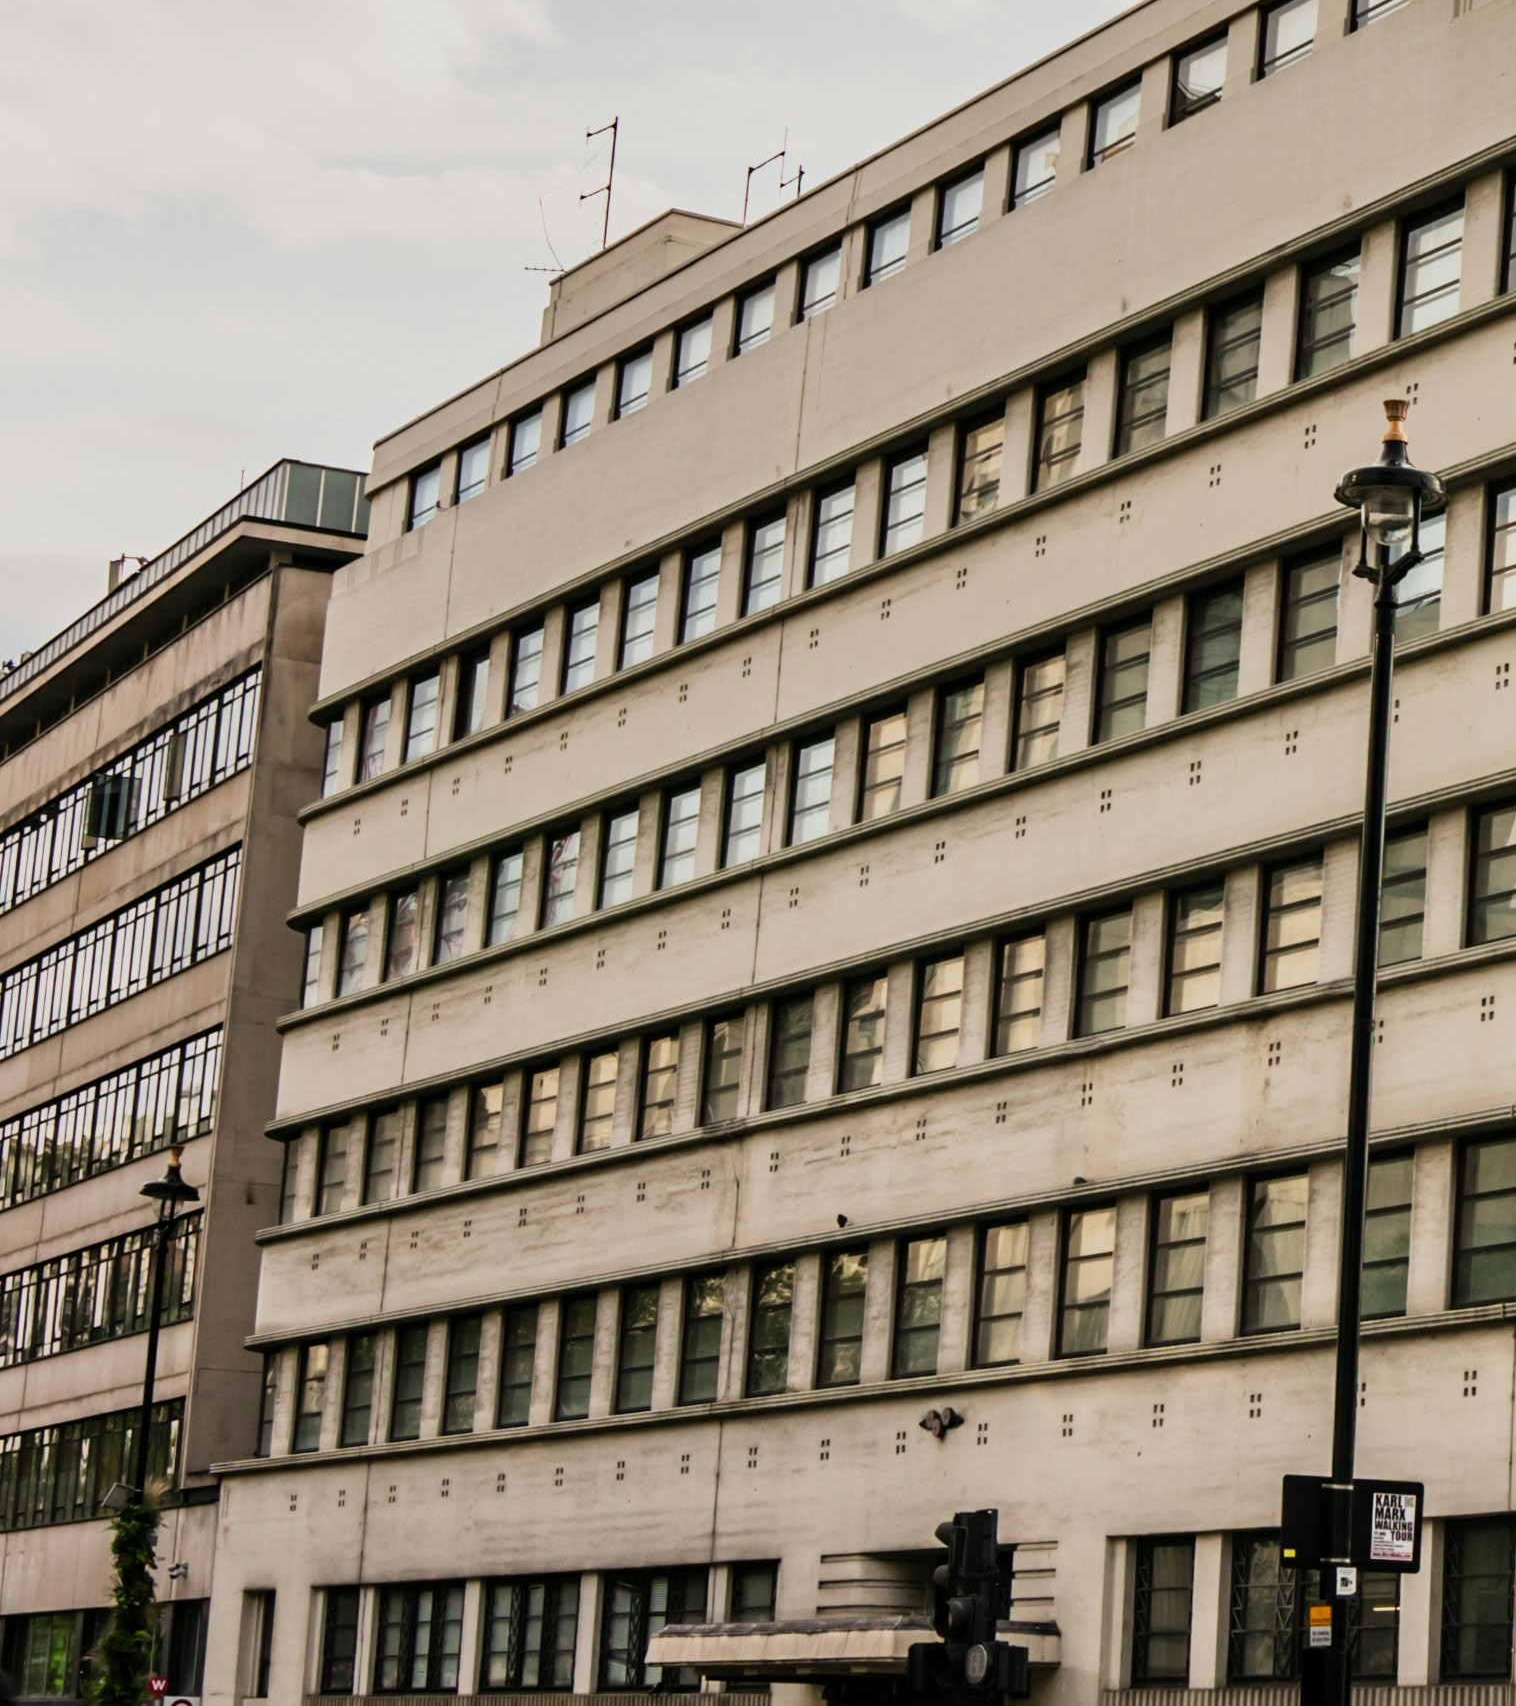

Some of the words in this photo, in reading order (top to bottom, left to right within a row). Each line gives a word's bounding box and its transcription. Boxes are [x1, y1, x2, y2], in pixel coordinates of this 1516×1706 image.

[1376, 1494, 1402, 1508] KARL
[1375, 1507, 1406, 1521] MARX
[1374, 1520, 1413, 1532] WALKING
[1390, 1530, 1413, 1542] TOUR
[151, 1679, 166, 1691] W
